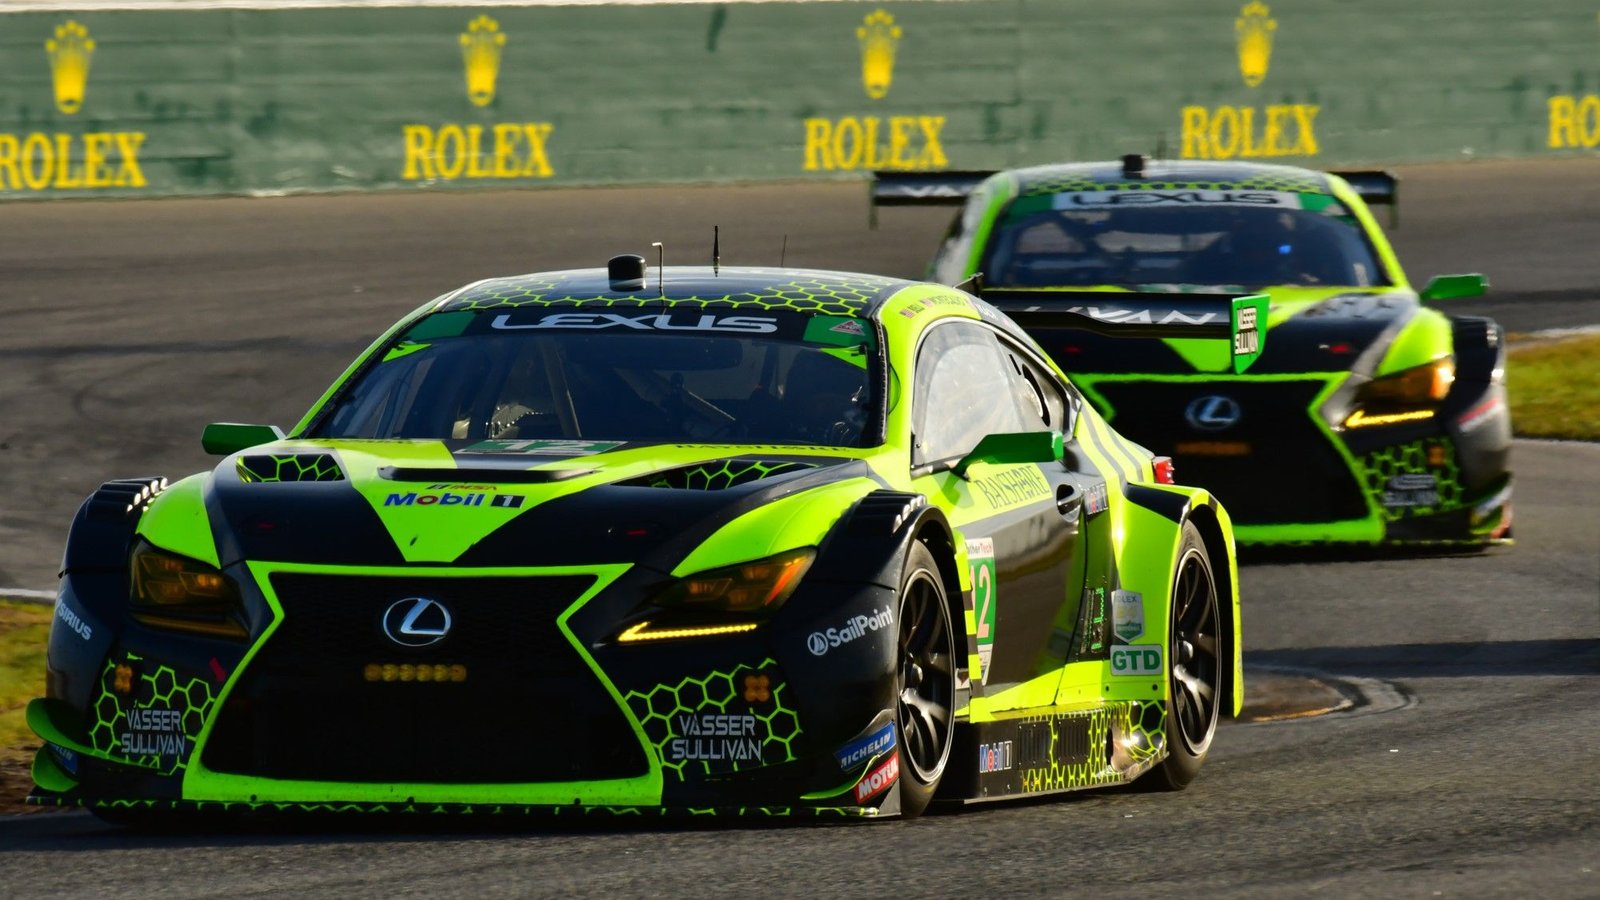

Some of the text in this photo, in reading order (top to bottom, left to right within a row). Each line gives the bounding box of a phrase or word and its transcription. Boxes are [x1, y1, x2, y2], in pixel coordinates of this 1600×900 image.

[803, 115, 948, 171] ROLEX
[1181, 104, 1320, 159] ROLEX
[0, 131, 148, 191] ROLEX
[403, 123, 554, 180] ROLEX
[1072, 192, 1281, 207] LEXUS
[491, 312, 778, 334] LEXUS
[384, 493, 526, 508] Mobil 1
[826, 605, 894, 648] SailPoint
[1112, 649, 1161, 671] GTD
[126, 709, 182, 731] VASSER
[679, 714, 756, 736] VASSER
[120, 733, 186, 756] SULLIVAN
[671, 738, 762, 761] SULLIVAN
